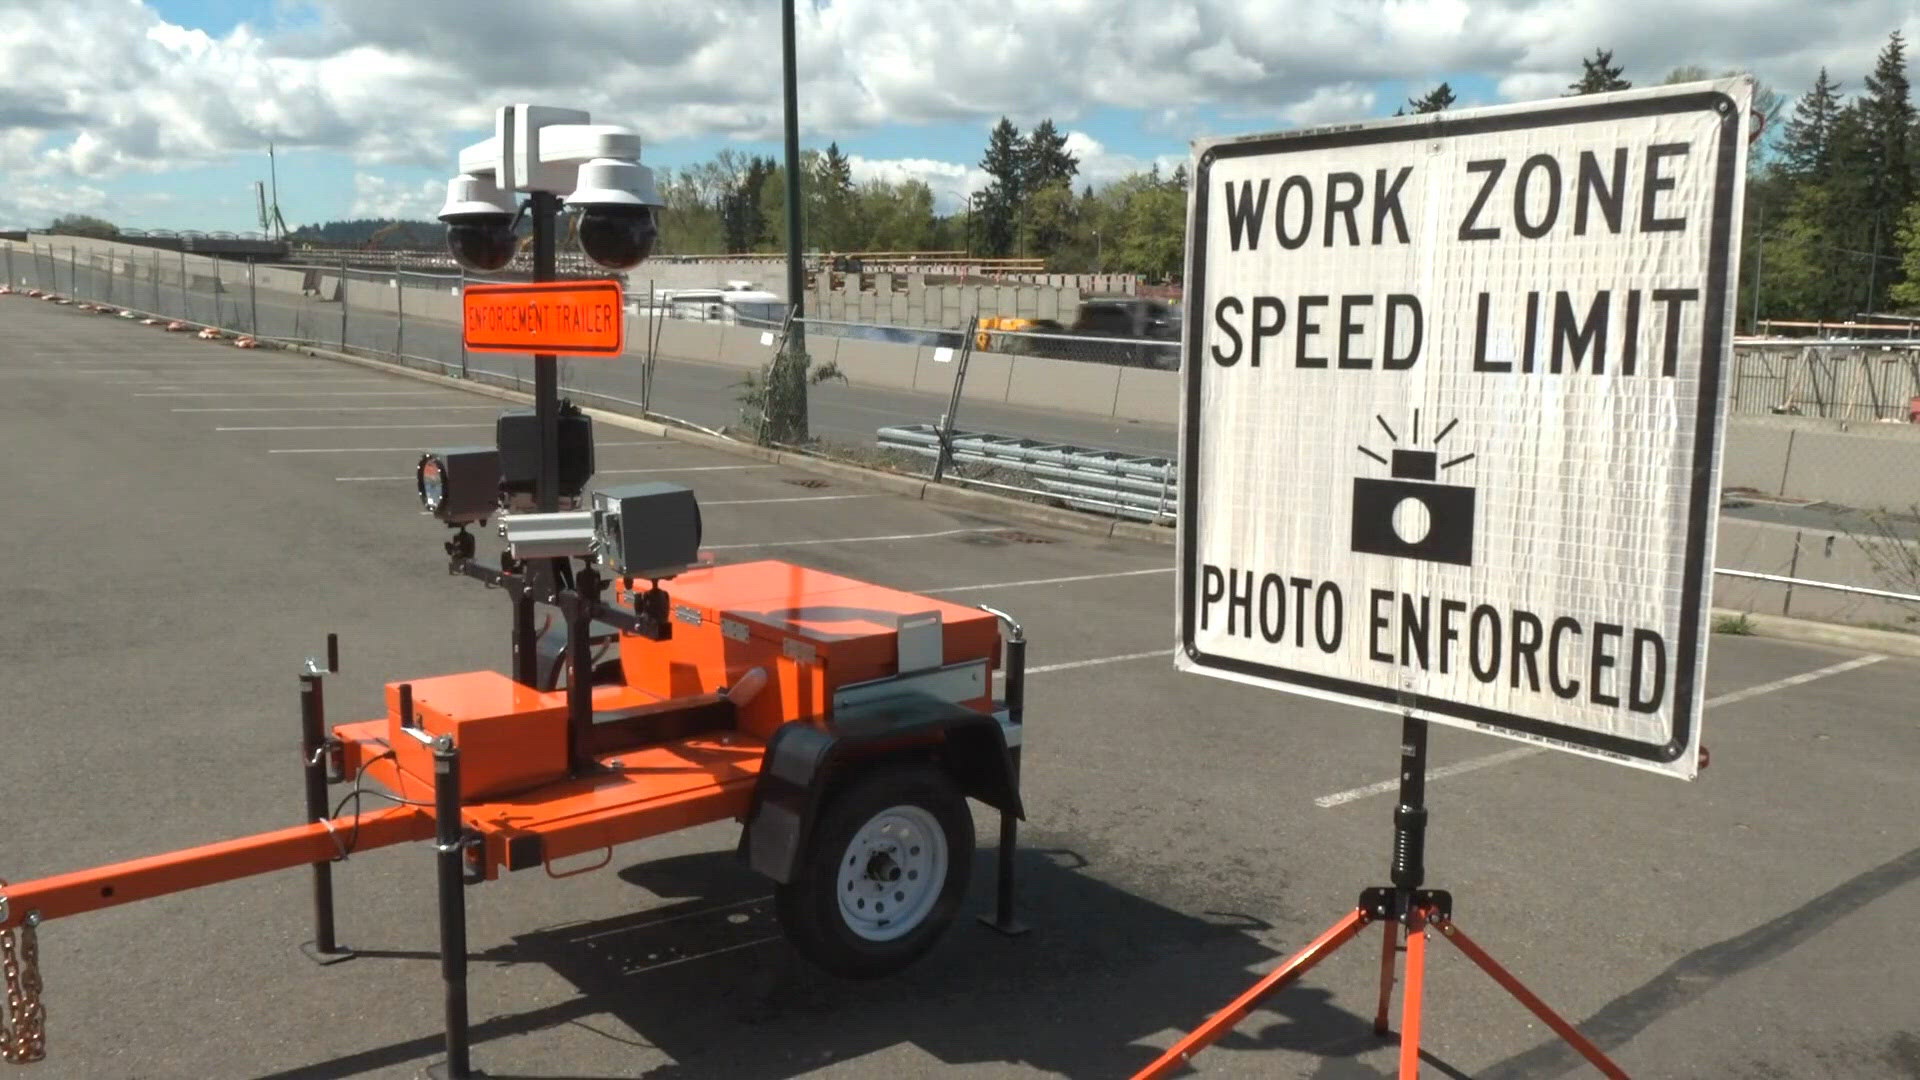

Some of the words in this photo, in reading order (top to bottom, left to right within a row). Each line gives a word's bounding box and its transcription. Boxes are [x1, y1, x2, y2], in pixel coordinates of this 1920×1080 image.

[1225, 166, 1414, 252] WORK
[1458, 142, 1690, 241] ZONE
[469, 304, 549, 333] ENFORCEMENT
[556, 304, 612, 333] TRAILER
[1211, 294, 1424, 370] SPEED
[1473, 288, 1699, 377] LIMIT
[1201, 564, 1343, 654] PHOTO
[1369, 588, 1667, 714] ENFORCED
